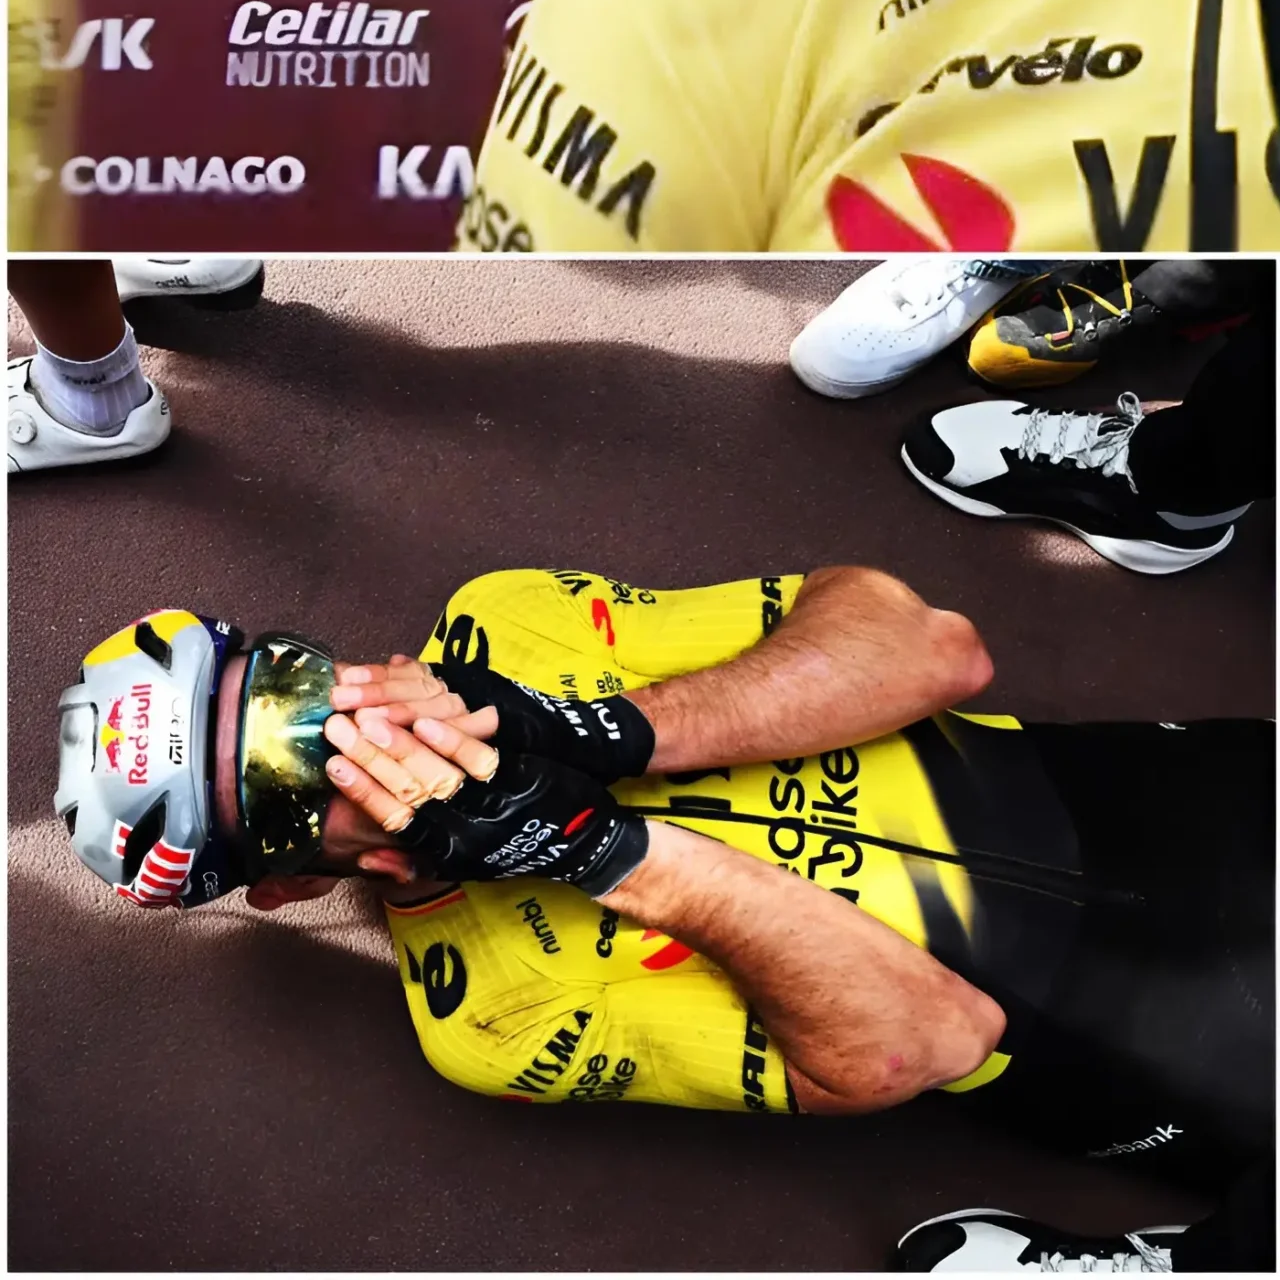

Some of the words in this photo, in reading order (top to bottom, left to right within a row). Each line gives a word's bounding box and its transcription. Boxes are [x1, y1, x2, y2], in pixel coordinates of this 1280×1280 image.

[229, 0, 431, 47] Cetilar
[226, 50, 431, 88] NUTRITION
[496, 43, 657, 244] VISMA
[60, 155, 306, 195] COLNAGO
